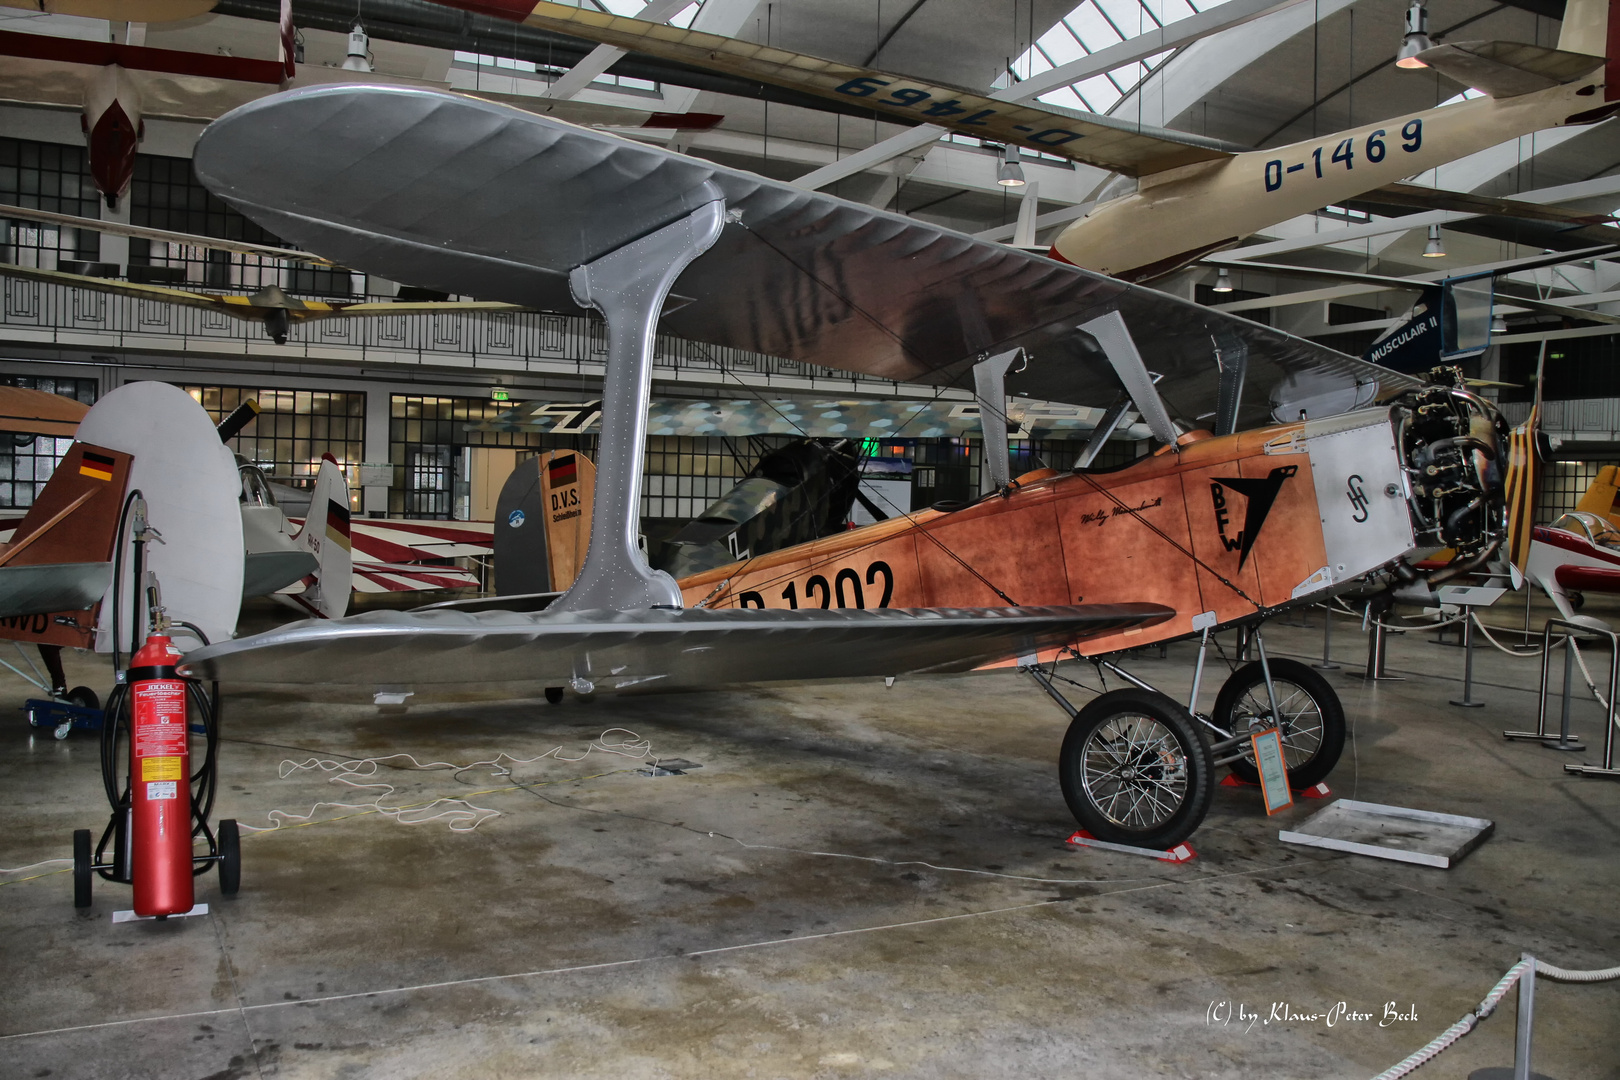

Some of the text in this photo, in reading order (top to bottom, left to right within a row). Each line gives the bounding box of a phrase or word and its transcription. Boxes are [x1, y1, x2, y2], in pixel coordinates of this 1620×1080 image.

[1264, 118, 1423, 193] D-1469
[1371, 316, 1438, 363] MUSCULAIR II
[551, 488, 581, 511] D.V.S.
[1210, 482, 1244, 552] BFW
